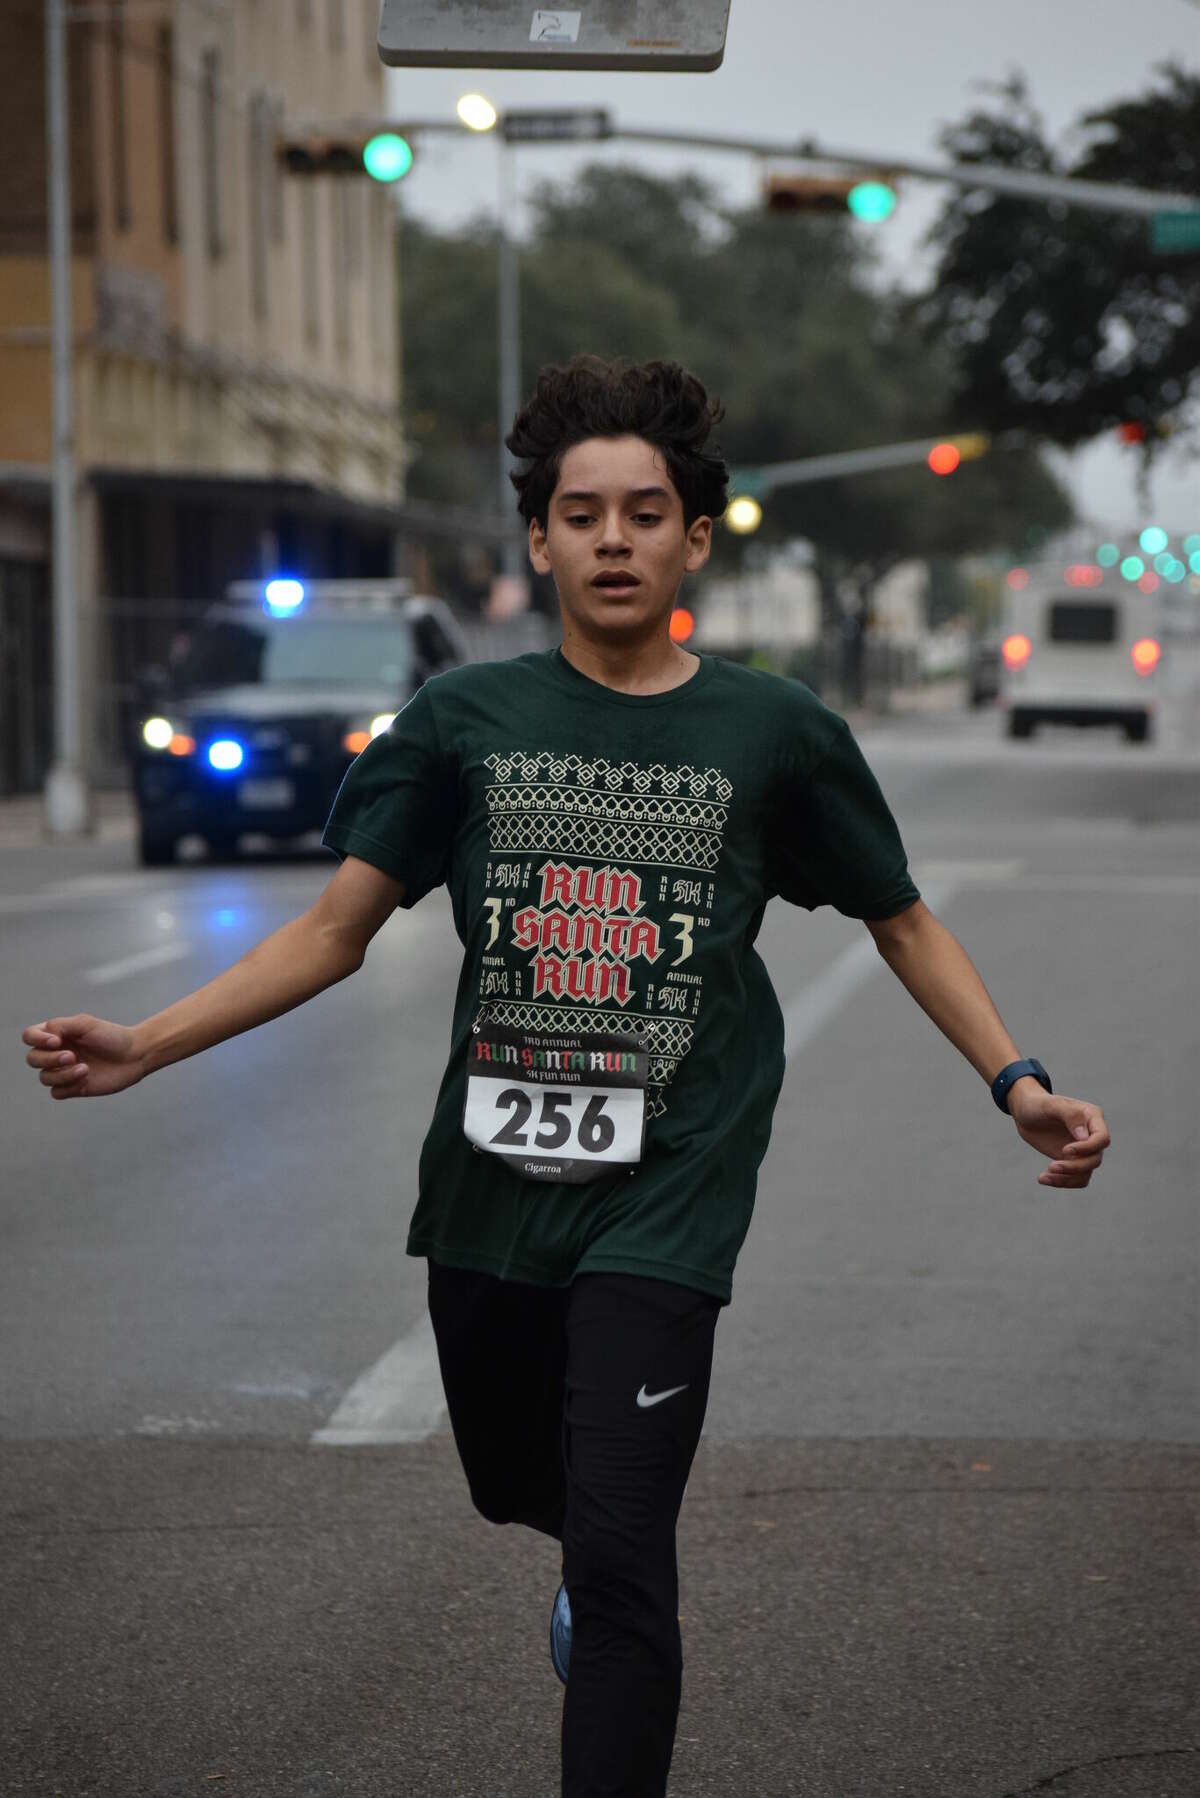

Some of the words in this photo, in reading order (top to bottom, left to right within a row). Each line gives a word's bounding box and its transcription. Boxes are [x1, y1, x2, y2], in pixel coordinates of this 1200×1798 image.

[537, 859, 646, 917] RUN
[510, 905, 665, 965] SANTA
[528, 951, 636, 1008] RUN
[476, 1040, 519, 1065] RUN
[521, 1050, 586, 1071] SANTA
[590, 1051, 637, 1073] RUN
[542, 1037, 582, 1048] ANNUAL
[488, 1088, 616, 1153] 256
[524, 1162, 562, 1175] Cigarroa
